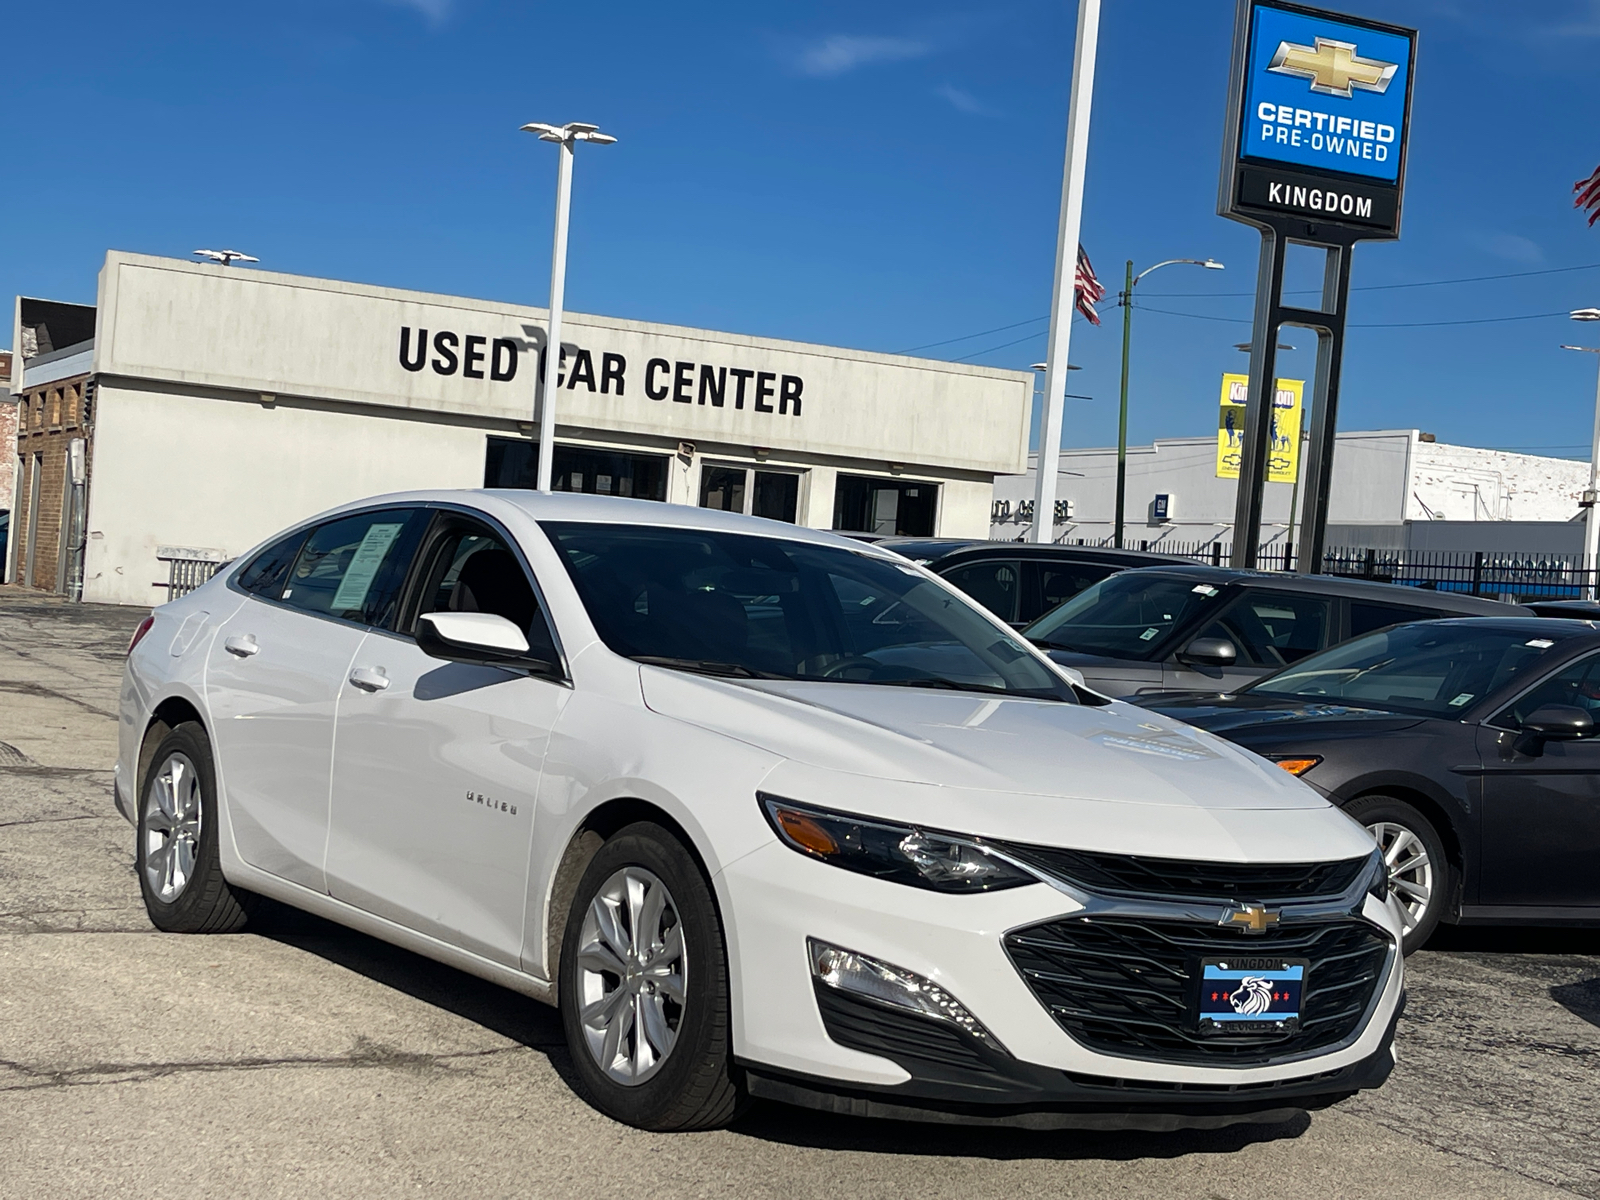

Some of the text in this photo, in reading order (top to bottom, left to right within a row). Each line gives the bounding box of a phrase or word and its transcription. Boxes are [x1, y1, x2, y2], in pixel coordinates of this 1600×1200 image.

[1257, 102, 1395, 143] CERTIFIED
[1261, 124, 1388, 162] PRE-OWNED
[1268, 182, 1372, 218] KINGDOM
[399, 326, 518, 382] USED
[644, 357, 804, 416] CENTER
[1227, 958, 1283, 970] KINGDOM
